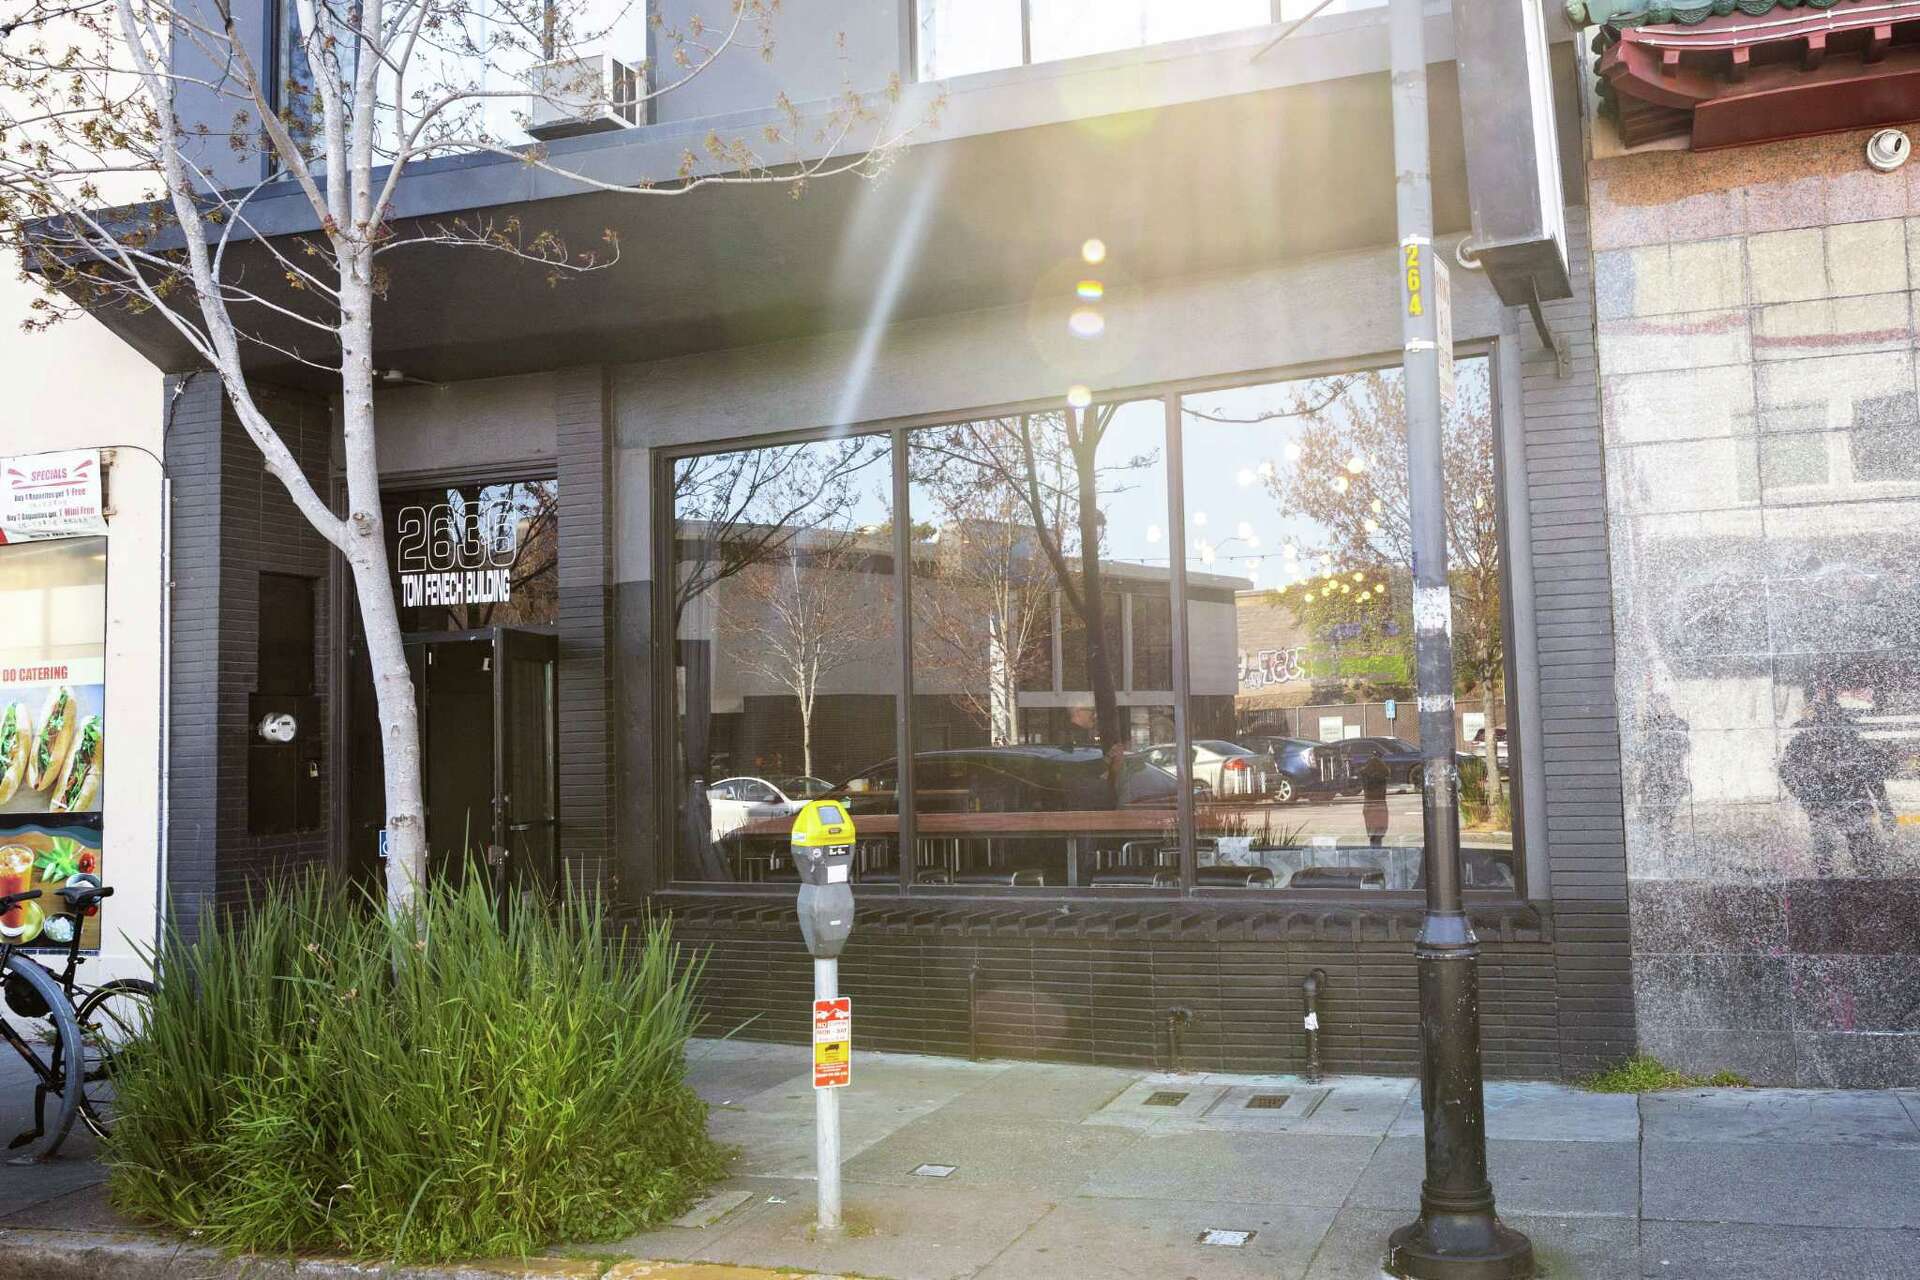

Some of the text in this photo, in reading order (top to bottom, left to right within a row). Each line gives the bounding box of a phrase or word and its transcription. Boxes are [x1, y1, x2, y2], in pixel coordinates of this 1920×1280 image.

[1406, 245, 1424, 316] 264
[397, 499, 517, 573] 2636
[401, 569, 511, 608] TOM FENECH BUILDING
[2, 665, 68, 682] DO CATERING
